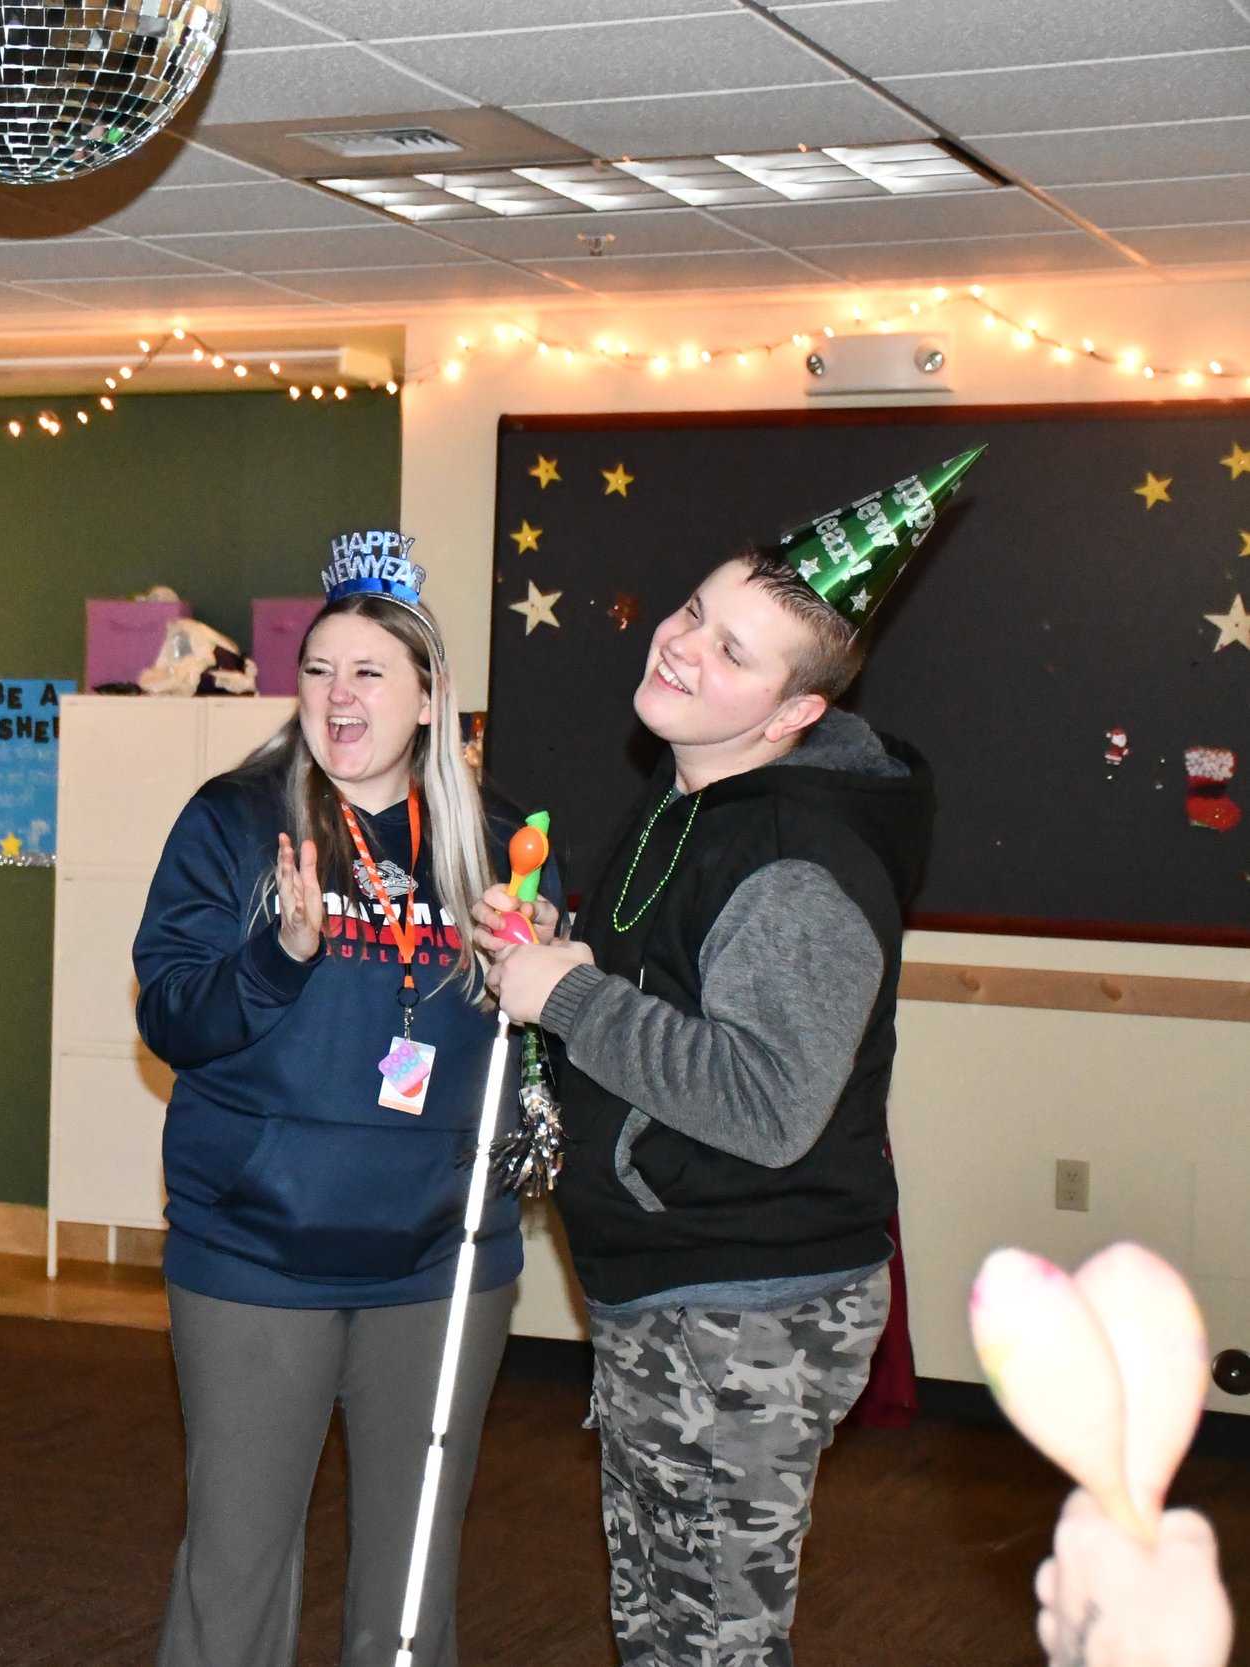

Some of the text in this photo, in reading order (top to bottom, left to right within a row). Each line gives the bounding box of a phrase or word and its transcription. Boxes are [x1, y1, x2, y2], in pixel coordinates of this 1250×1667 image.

[892, 474, 936, 547] app
[331, 531, 416, 561] HAPPY
[40, 683, 58, 706] A
[275, 892, 462, 950] ONZA
[325, 944, 469, 970] ULLOG
